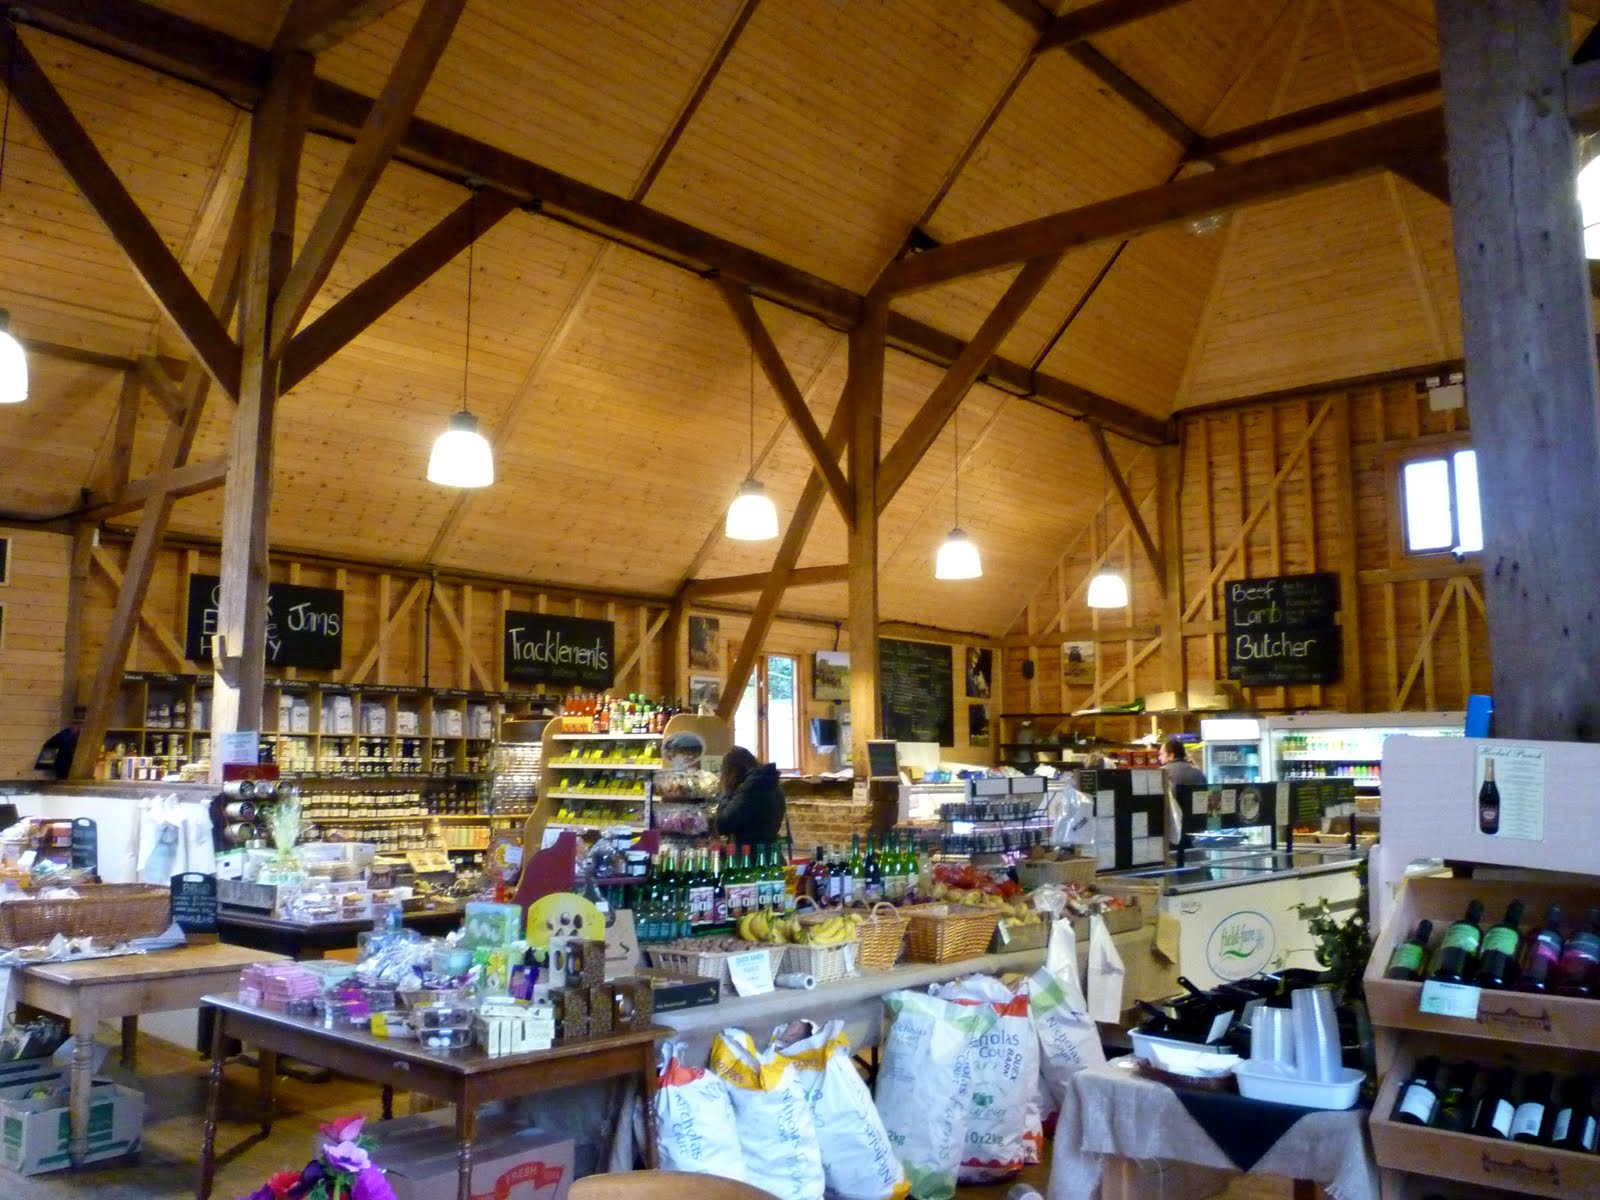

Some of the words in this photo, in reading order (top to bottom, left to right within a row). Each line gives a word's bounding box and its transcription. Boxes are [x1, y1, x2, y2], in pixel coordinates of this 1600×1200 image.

[1232, 581, 1276, 602] Beef
[288, 602, 340, 637] Jams
[508, 627, 609, 671] Tracklements
[1236, 631, 1317, 660] Butcher
